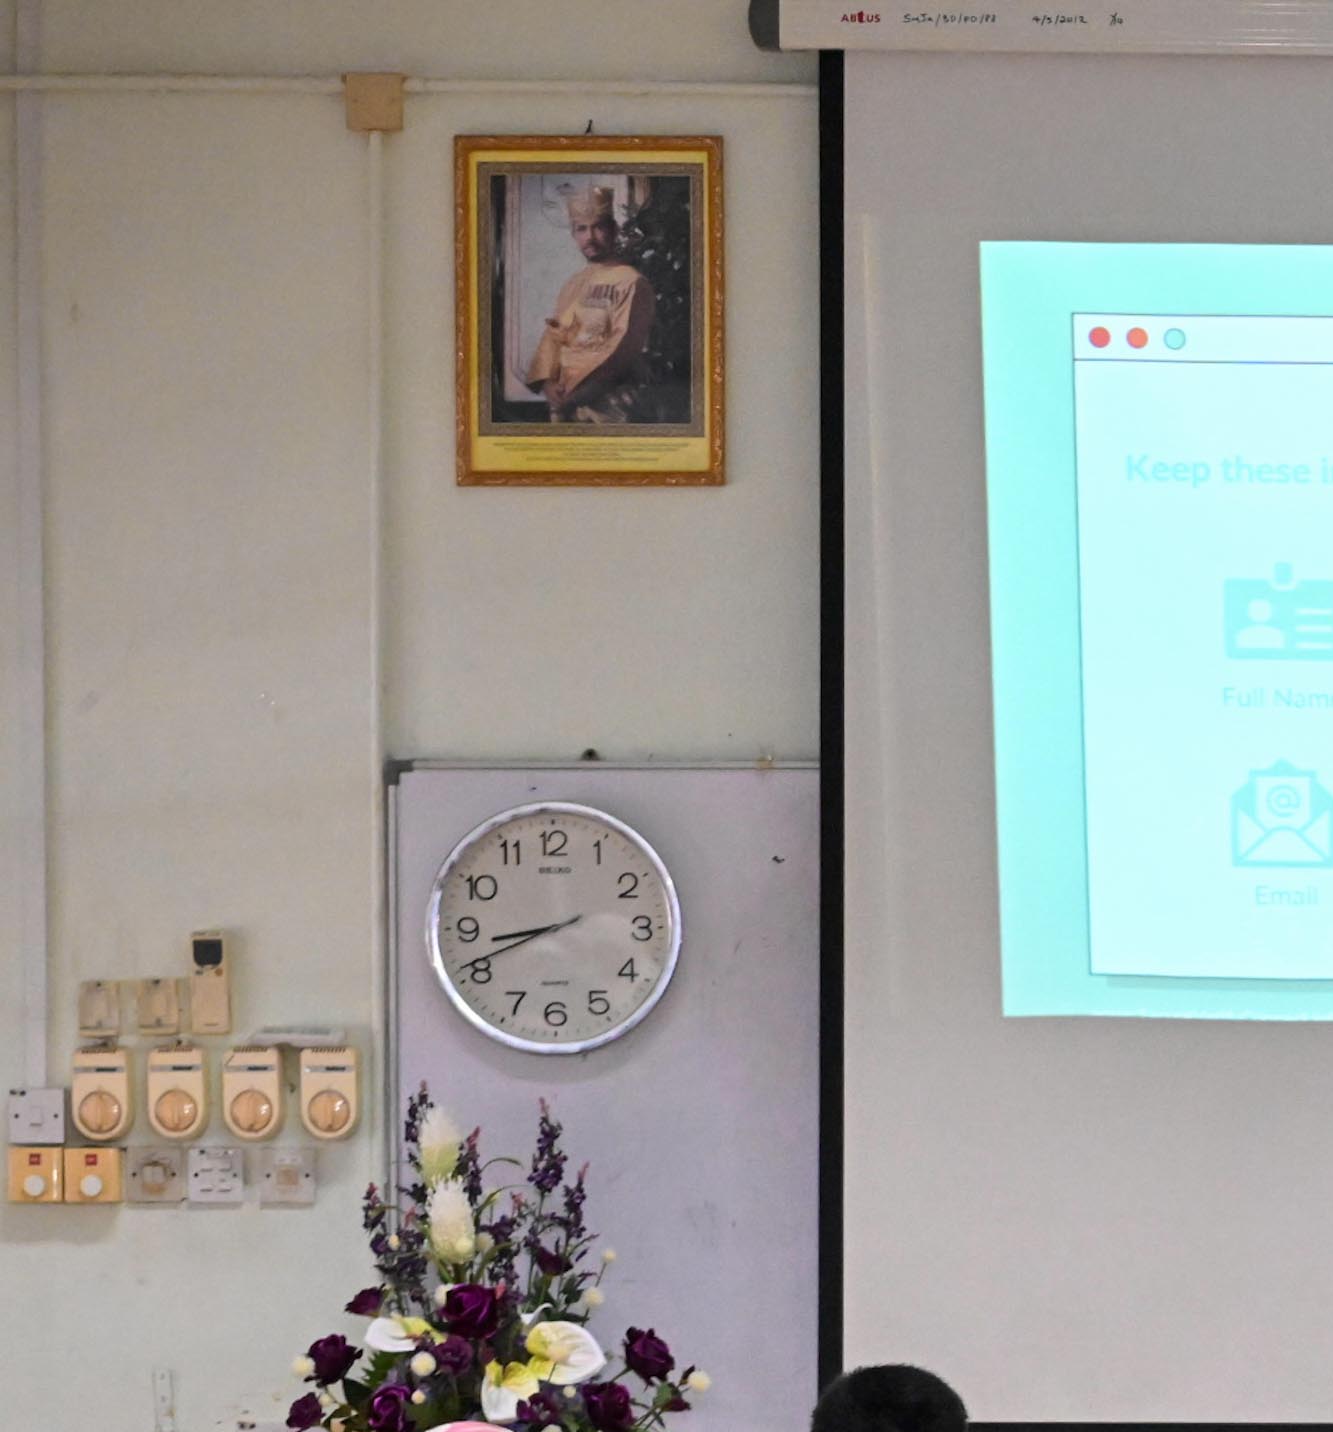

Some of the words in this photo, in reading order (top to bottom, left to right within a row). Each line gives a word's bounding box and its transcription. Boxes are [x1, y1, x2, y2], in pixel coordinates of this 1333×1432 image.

[1122, 451, 1212, 490] Keep
[1218, 453, 1314, 487] these
[1220, 685, 1266, 708] Full
[499, 839, 520, 866] 11
[539, 830, 568, 856] 12
[593, 840, 601, 865] 1
[464, 874, 498, 901] 10
[617, 872, 639, 899] 2
[1254, 884, 1322, 908] Email
[456, 916, 479, 943] 9
[632, 915, 653, 942] 3
[470, 957, 493, 984] 8
[617, 957, 639, 983] 4
[505, 991, 527, 1016] 7
[544, 1002, 568, 1027] 6
[588, 990, 610, 1016] 5
